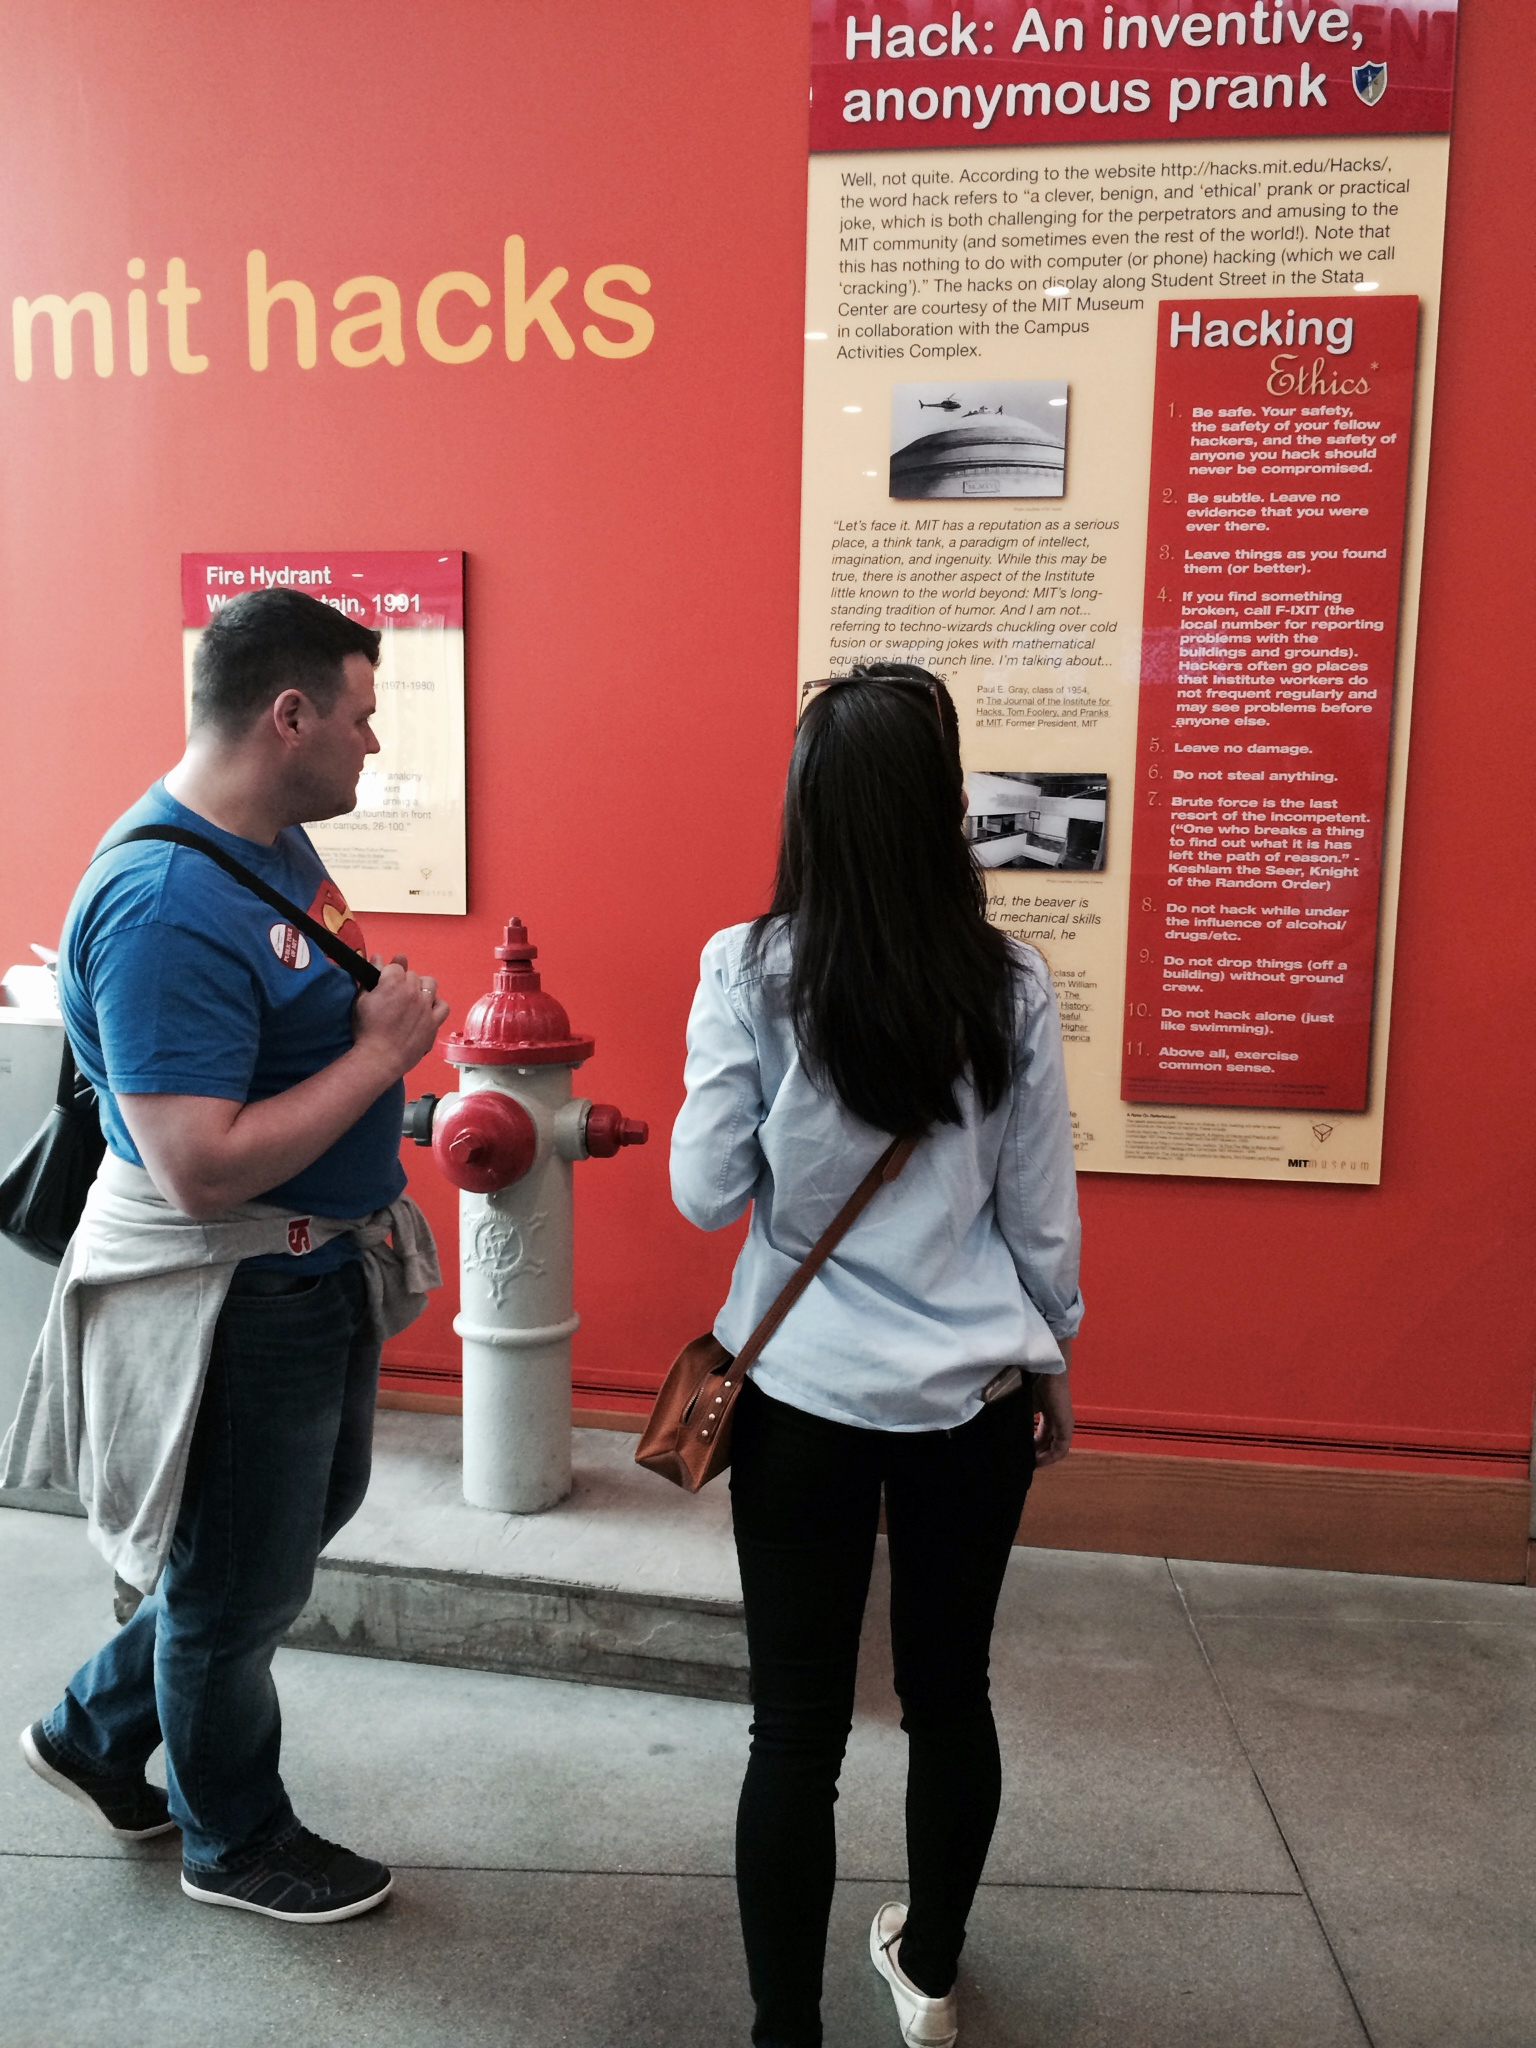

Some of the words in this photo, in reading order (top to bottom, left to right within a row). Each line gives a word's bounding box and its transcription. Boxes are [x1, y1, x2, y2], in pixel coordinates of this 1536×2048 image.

[846, 10, 994, 60] Hack:
[1012, 7, 1083, 54] An
[1102, 0, 1364, 50] inventive,
[842, 78, 1150, 130] anonymous
[1169, 62, 1327, 123] prank
[840, 172, 876, 186] Well,
[882, 171, 906, 185] not
[911, 170, 953, 187] quite.
[959, 167, 1038, 184] According
[1044, 166, 1059, 180] to
[1064, 165, 1089, 179] the
[1094, 163, 1155, 178] website
[1161, 156, 1391, 179] http://hacks.mit.edu/Hacks/,
[840, 194, 864, 208] the
[869, 192, 906, 207] word
[912, 191, 948, 206] hack
[954, 190, 997, 205] refers
[1002, 190, 1017, 203] to
[1023, 189, 1039, 202] “a
[1044, 188, 1093, 202] clever,
[1100, 185, 1157, 203] benign,
[1163, 184, 1193, 198] and
[1200, 182, 1260, 197] ‘ethical’
[1267, 180, 1312, 199] prank
[1318, 183, 1334, 195] or
[1340, 178, 1409, 197] practical
[839, 216, 874, 233] joke,
[880, 214, 925, 228] which
[930, 216, 942, 227] is
[948, 212, 982, 227] both
[987, 210, 1076, 228] challenging
[1082, 208, 1103, 223] for
[1108, 208, 1132, 222] the
[1138, 206, 1236, 224] perpetrators
[1241, 204, 1271, 218] and
[1277, 202, 1345, 220] amusing
[1351, 202, 1367, 216] to
[1372, 201, 1398, 215] the
[12, 257, 210, 382] mit
[246, 234, 655, 372] hacks
[1170, 309, 1354, 354] Hacking
[1192, 407, 1213, 417] Be
[1217, 406, 1256, 417] safe.
[1260, 406, 1296, 416] Your
[1300, 405, 1353, 417] safety,
[1190, 421, 1216, 431] the
[1220, 420, 1270, 433] safety
[1273, 420, 1290, 430] of
[1294, 421, 1329, 432] your
[1332, 419, 1380, 430] fellow
[1190, 435, 1257, 447] hackers,
[1262, 434, 1292, 445] and
[1296, 434, 1322, 444] the
[1326, 433, 1376, 446] safety
[1379, 433, 1396, 443] of
[1189, 451, 1245, 462] anyone
[1249, 451, 1277, 462] you
[1281, 448, 1320, 459] hack
[1324, 447, 1376, 458] should
[1188, 466, 1233, 474] never
[1236, 463, 1256, 474] be
[1261, 462, 1372, 475] compromised.
[833, 520, 866, 531] “Let’s
[870, 519, 896, 531] face
[899, 520, 909, 530] it.
[914, 519, 940, 530] MIT
[941, 519, 963, 530] has
[966, 521, 974, 530] a
[978, 519, 1041, 532] reputation
[1044, 521, 1059, 530] as
[1062, 521, 1070, 530] a
[1074, 520, 1119, 530] serious
[831, 536, 867, 550] place,
[871, 539, 879, 547] a
[883, 536, 912, 547] think
[915, 537, 943, 548] tank,
[948, 538, 956, 547] a
[958, 536, 1018, 550] paradigm
[1022, 535, 1035, 547] of
[1037, 536, 1089, 548] intellect,
[831, 554, 903, 567] imagination,
[908, 553, 932, 564] and
[934, 554, 991, 567] ingenuity.
[998, 553, 1031, 564] While
[1035, 553, 1056, 564] this
[1060, 555, 1087, 566] may
[1090, 553, 1106, 564] be
[206, 566, 244, 585] Fire
[250, 566, 332, 589] Hydrant
[1006, 707, 1024, 716] Tom
[1061, 708, 1077, 717] and
[1079, 708, 1108, 717] Pranks
[1005, 718, 1035, 727] Former
[1174, 742, 1219, 752] Leave
[1223, 745, 1242, 753] no
[1246, 743, 1312, 755] damage.
[1173, 769, 1194, 779] Do
[1198, 770, 1222, 780] not
[1226, 770, 1264, 780] steal
[1268, 770, 1338, 783] anything.
[363, 810, 399, 818] fountain
[401, 810, 408, 818] in
[411, 810, 431, 819] front
[1012, 896, 1030, 907] the
[1034, 896, 1076, 907] beaver
[1078, 897, 1089, 908] is
[1000, 912, 1069, 923] mechanical
[1072, 913, 1102, 924] skills
[1061, 929, 1076, 940] he
[1161, 1007, 1181, 1017] Do
[1186, 1009, 1210, 1018] not
[1214, 1009, 1250, 1020] hack
[1254, 1011, 1296, 1021] alone
[1300, 1012, 1334, 1023] (just
[1061, 1023, 1088, 1032] Higher
[1160, 1020, 1185, 1030] like
[1190, 1022, 1273, 1035] swimming).
